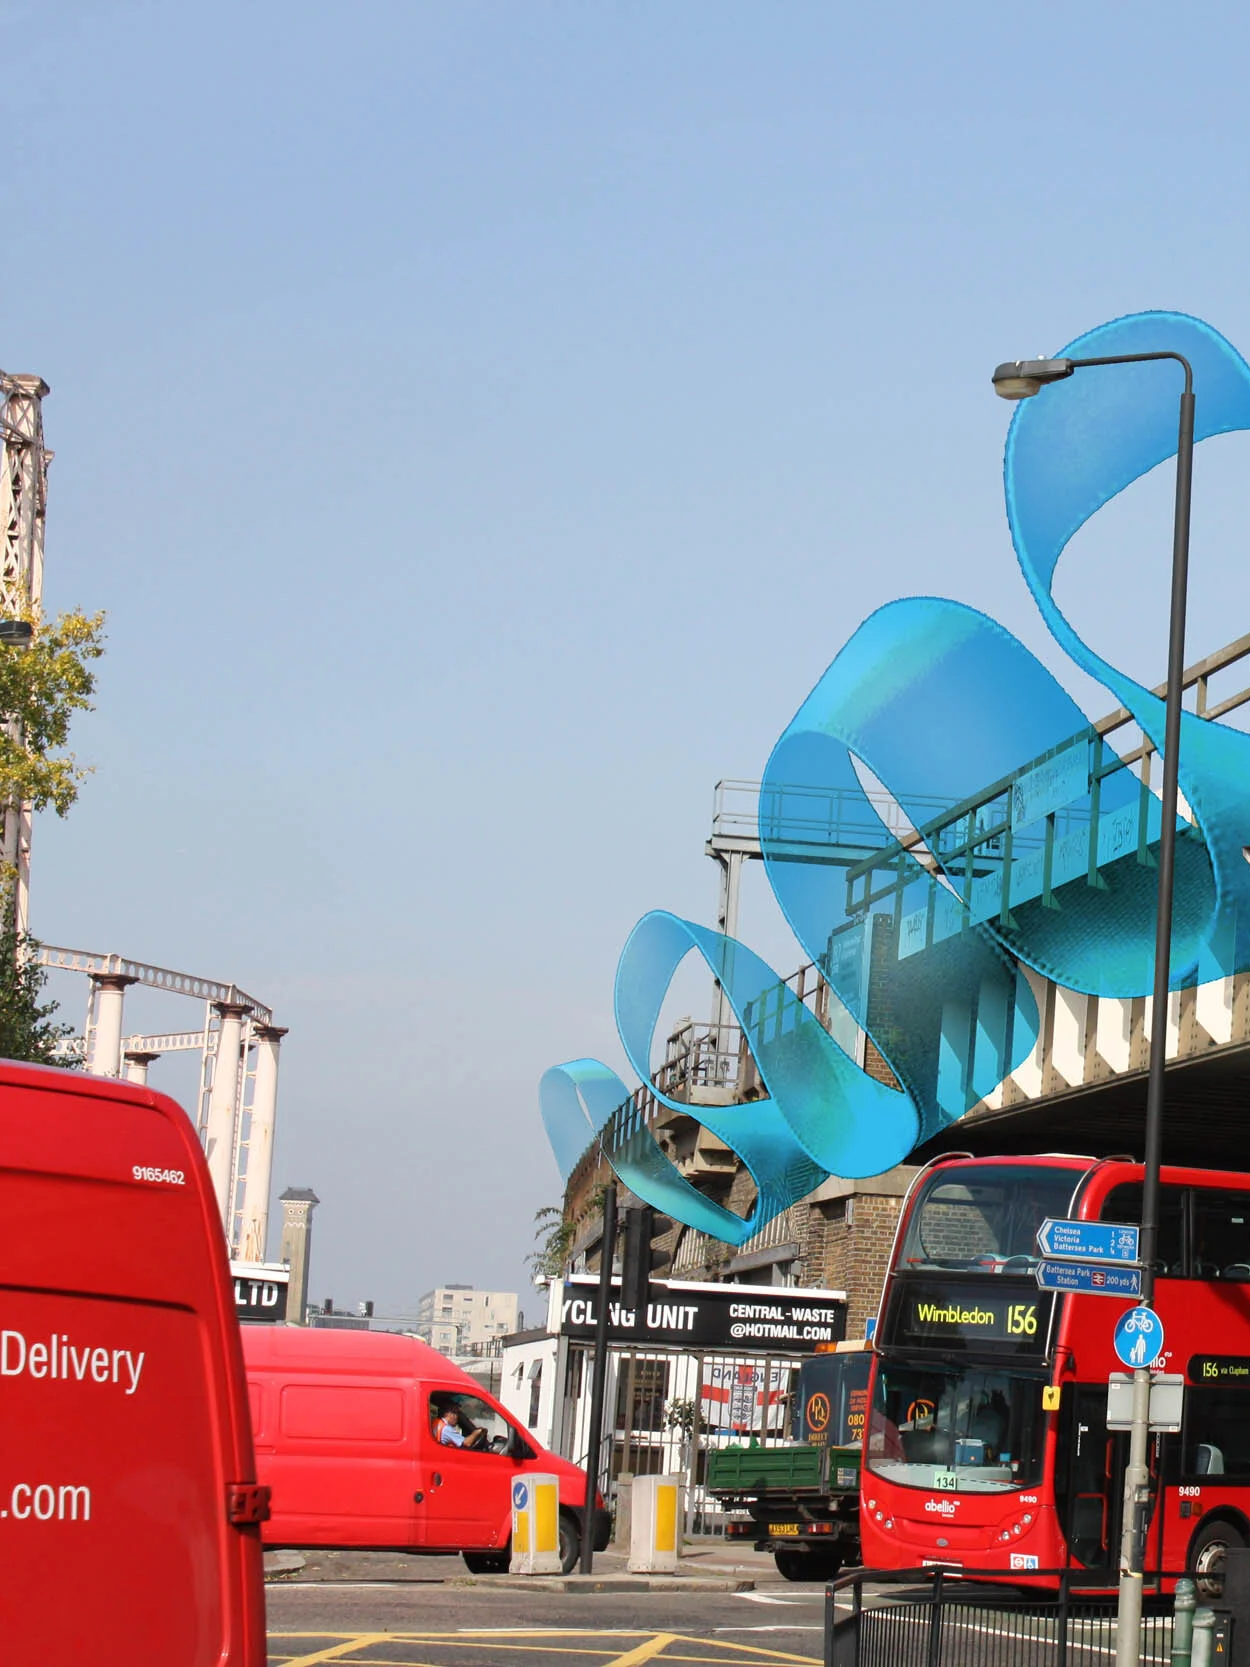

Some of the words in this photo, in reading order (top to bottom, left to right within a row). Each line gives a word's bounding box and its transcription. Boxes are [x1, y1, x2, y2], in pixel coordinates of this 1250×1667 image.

[132, 1165, 186, 1185] 9165462
[1054, 1226, 1081, 1235] Chelsea
[1053, 1234, 1080, 1244] Victoria
[1053, 1242, 1086, 1252] Battersea
[1088, 1245, 1104, 1254] Park
[1046, 1265, 1075, 1276] Battersea
[1076, 1267, 1090, 1278] Park
[1106, 1277, 1118, 1285] 200
[1119, 1278, 1129, 1287] yds
[1056, 1276, 1079, 1286] Station
[235, 1280, 279, 1307] LTD
[561, 1299, 636, 1328] YCLNG
[646, 1303, 699, 1330] UNIT
[918, 1303, 994, 1325] Wimbledon
[1007, 1304, 1038, 1335] 156
[730, 1323, 832, 1341] @HOTMAIL.COM
[1, 1329, 145, 1395] Delivery
[1203, 1362, 1218, 1377] 156
[1228, 1366, 1249, 1376] Clapham
[851, 1428, 865, 1440] 73
[936, 1476, 955, 1488] 134
[1178, 1486, 1201, 1497] 9490
[0, 1482, 91, 1521] .com
[924, 1499, 956, 1514] abellio
